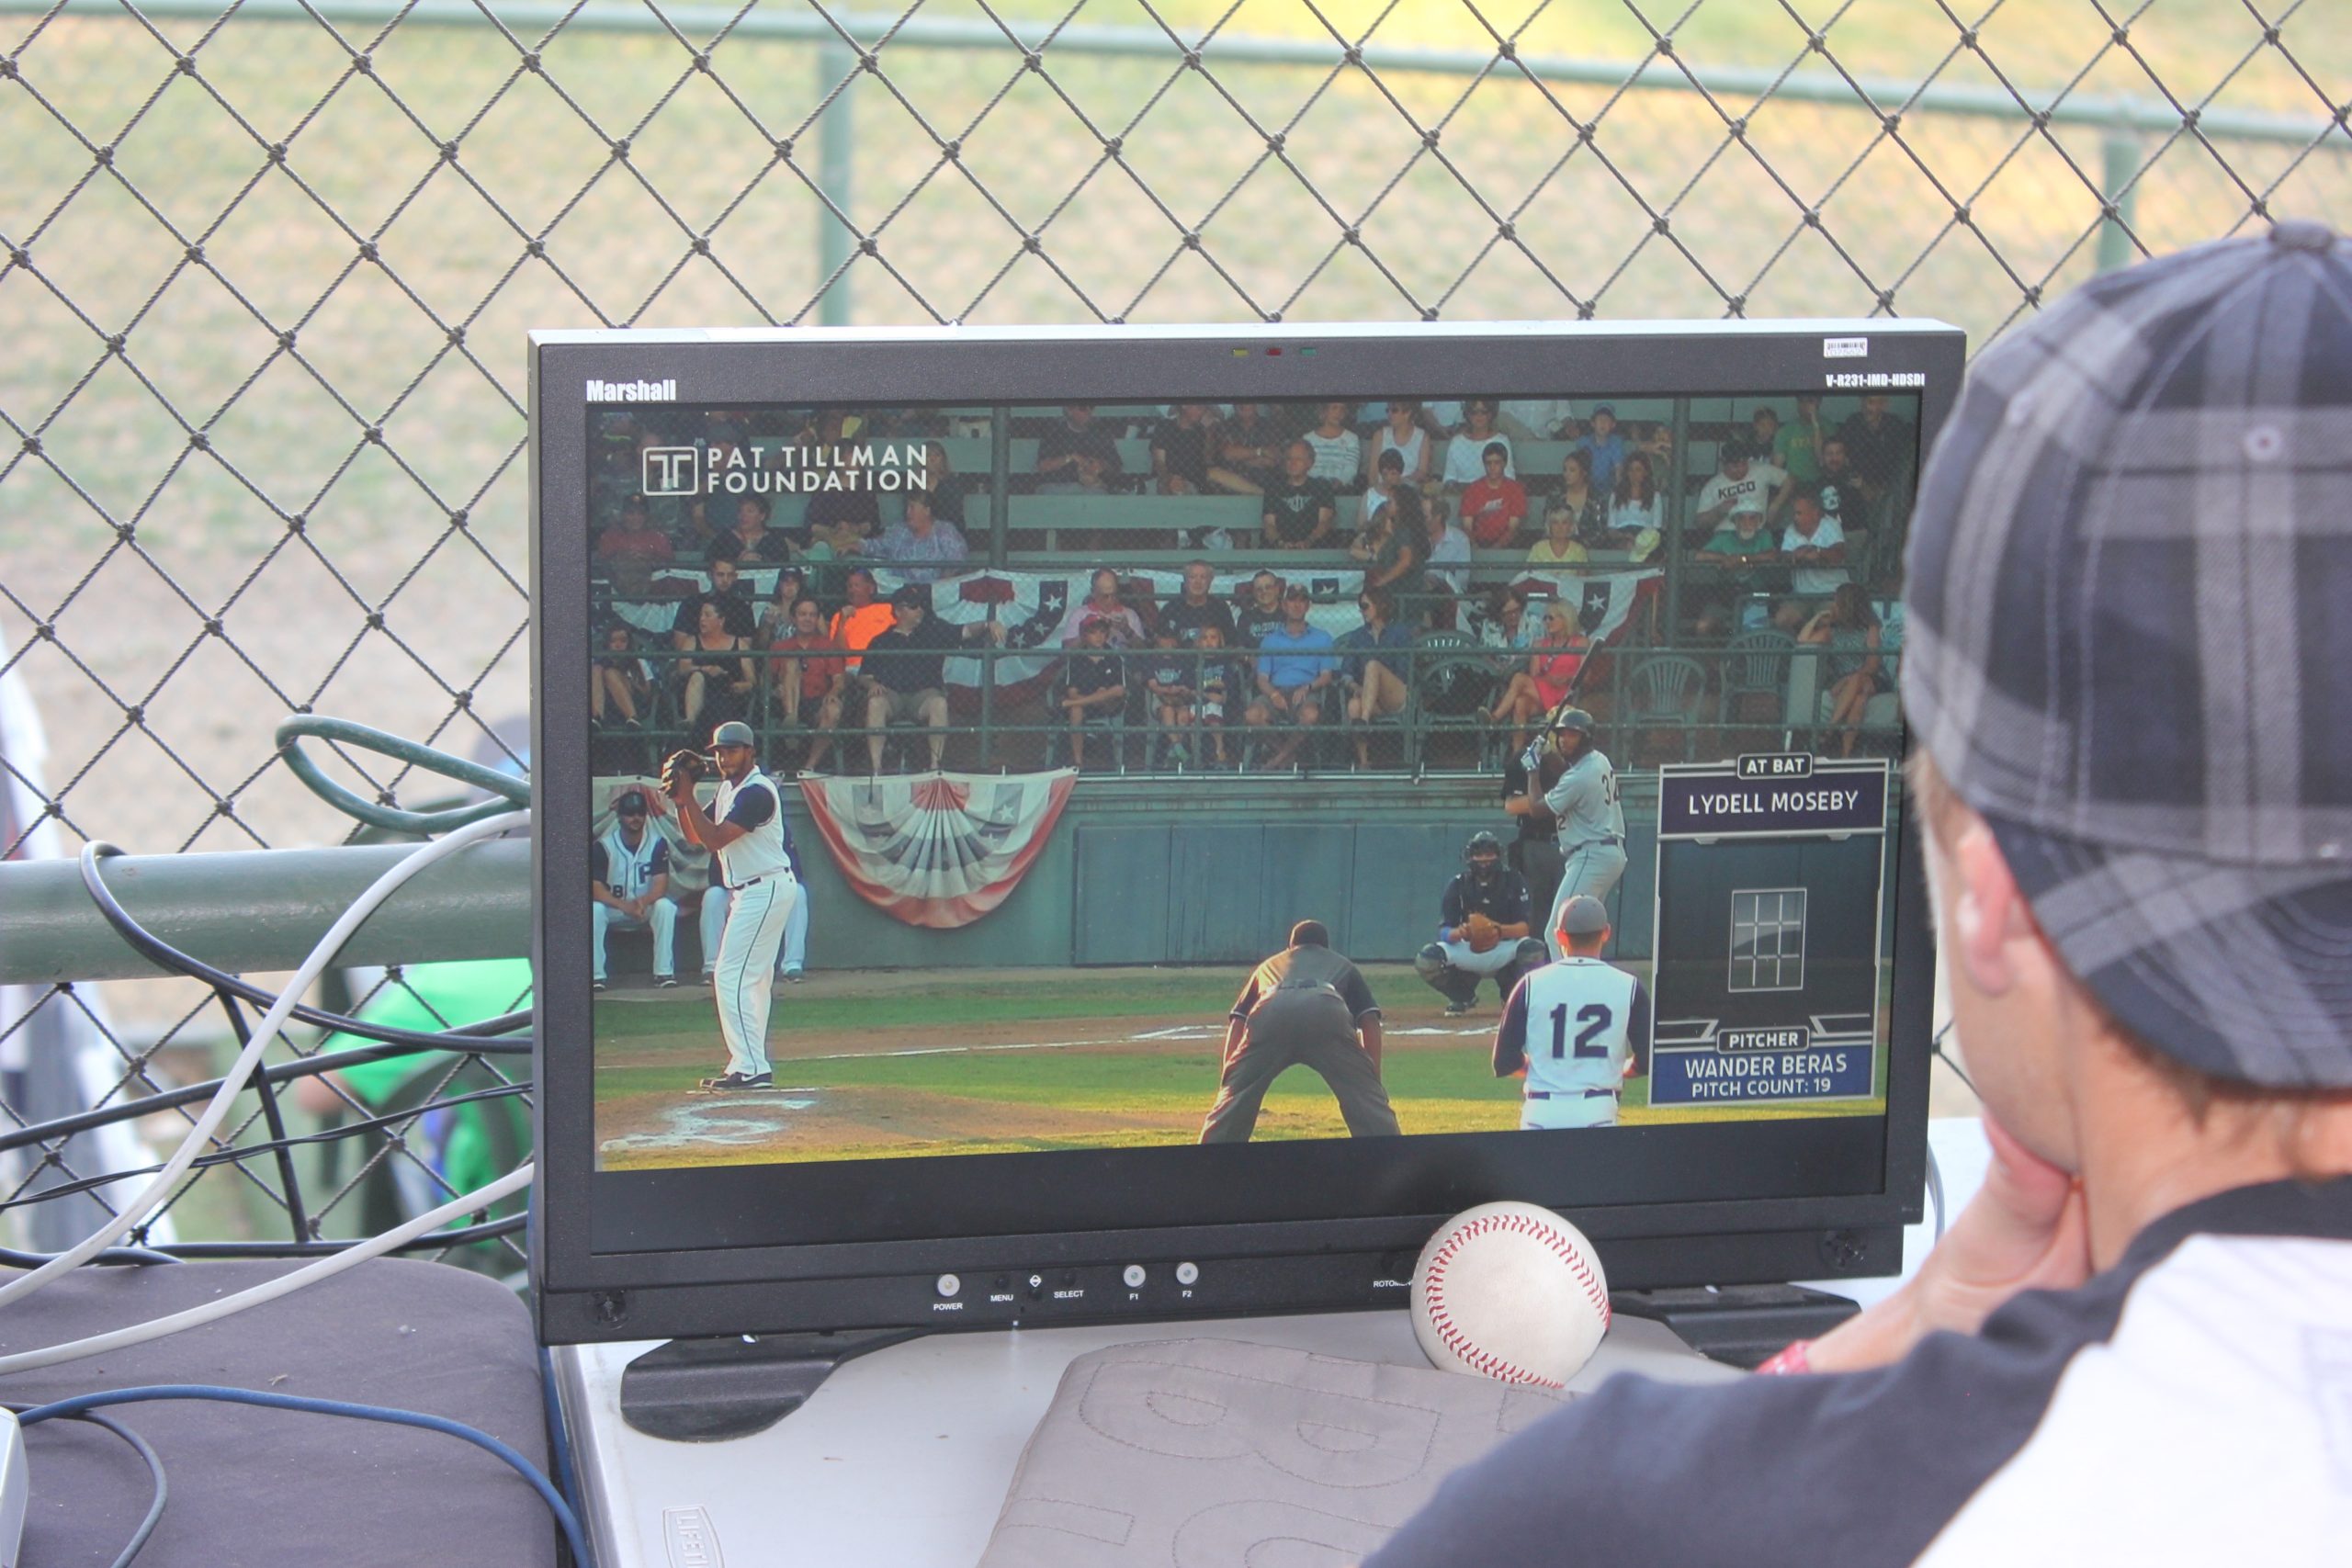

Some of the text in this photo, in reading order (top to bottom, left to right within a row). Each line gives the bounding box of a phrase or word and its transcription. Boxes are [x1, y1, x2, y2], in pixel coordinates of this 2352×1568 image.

[586, 379, 676, 401] Marshall
[1826, 373, 1926, 388] V-R231-IMD-HDSDI
[707, 445, 927, 469] PAT TILLMAN
[707, 469, 927, 493] FOUNDATION
[1717, 479, 1757, 501] KCCO
[1747, 758, 1804, 774] AT BAT
[1689, 790, 1859, 815] LYDELL MOSEBY
[1550, 1003, 1612, 1059] 12
[1729, 1032, 1798, 1049] PITCHER
[1685, 1054, 1848, 1079] WANDER BERAS
[1691, 1077, 1831, 1098] PITCH COUNT: 19
[1054, 1290, 1084, 1299] SELECT
[1182, 1290, 1193, 1298] F2
[1373, 1280, 1411, 1288] ROTO
[933, 1303, 963, 1311] POWER
[990, 1293, 1013, 1302] MENU
[677, 1516, 708, 1568] LIFETI
